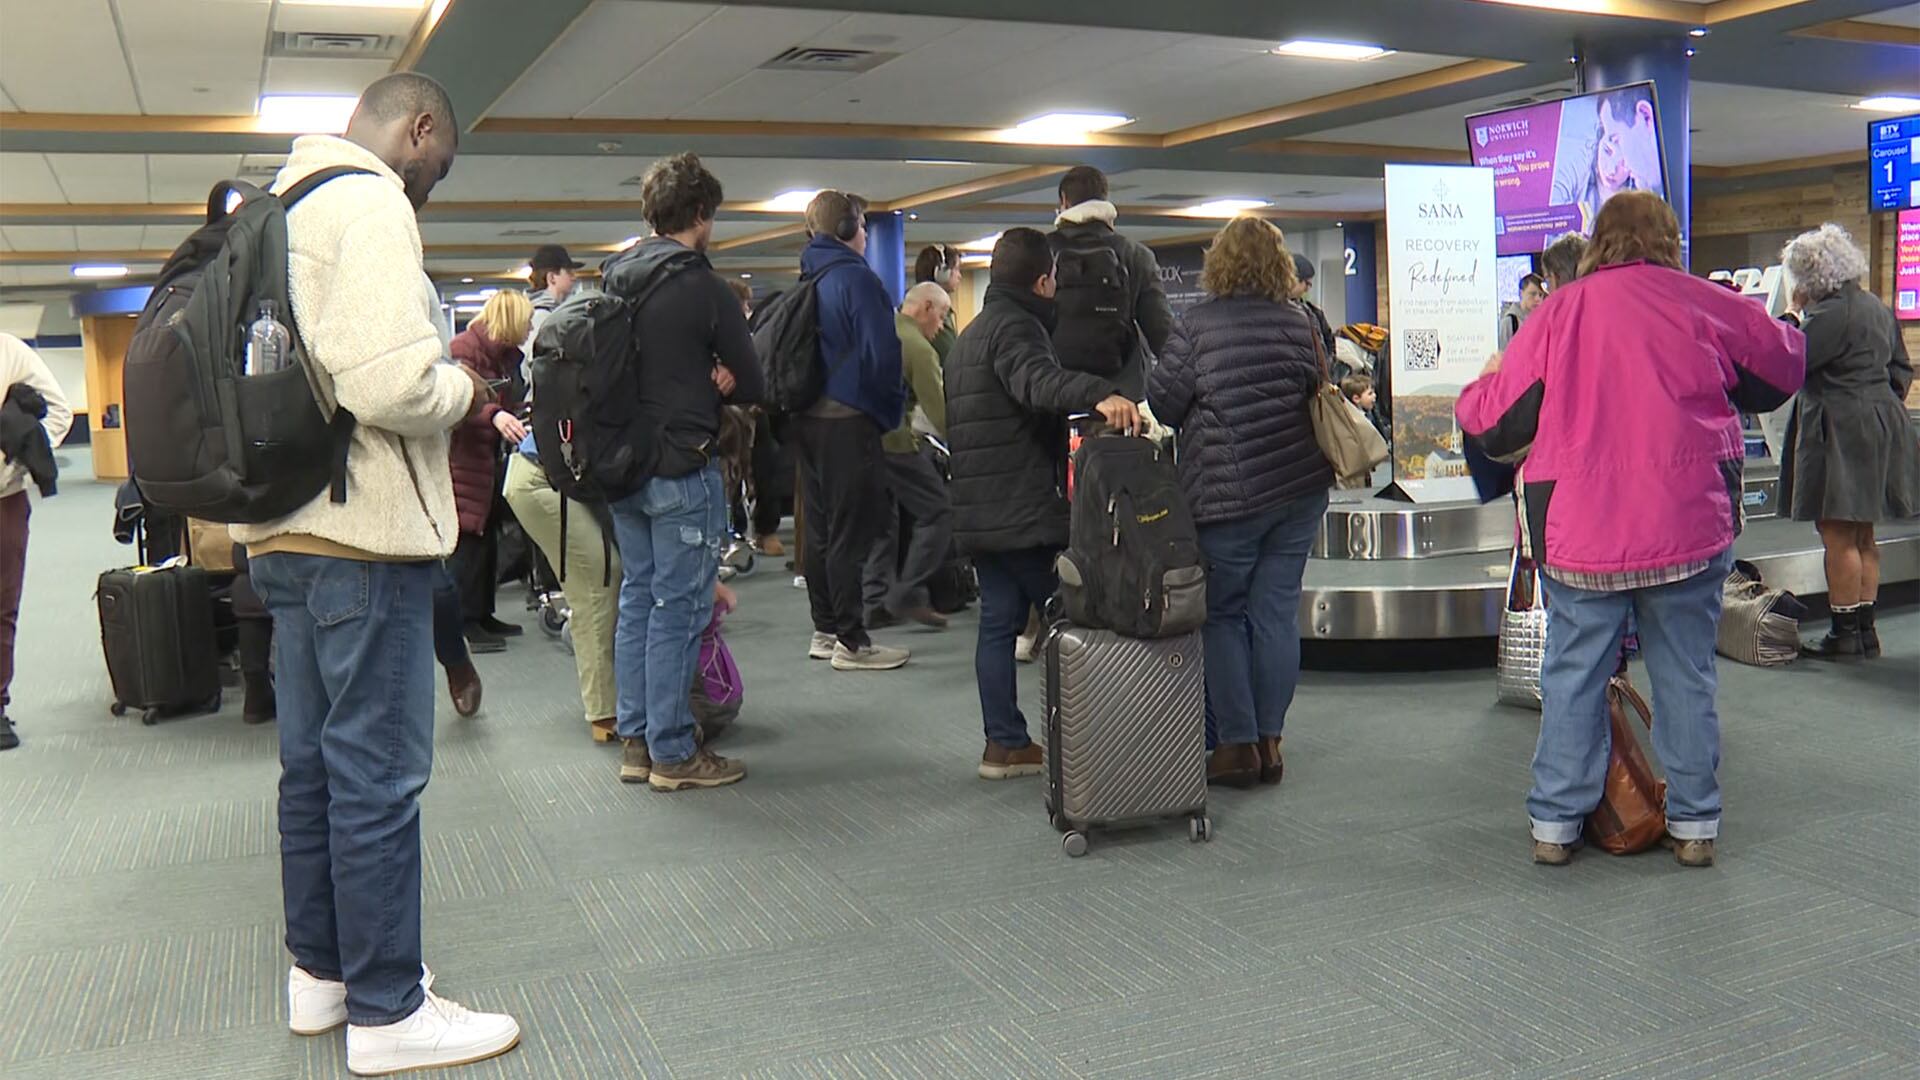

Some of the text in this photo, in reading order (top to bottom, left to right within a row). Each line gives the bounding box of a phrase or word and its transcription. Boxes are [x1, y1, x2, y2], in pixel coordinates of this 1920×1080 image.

[1489, 120, 1528, 135] NORWICH
[1880, 124, 1899, 135] BTV
[1479, 150, 1537, 166] When they say it's
[1873, 145, 1908, 158] Carousel
[1517, 162, 1530, 172] You
[1530, 161, 1550, 172] prove
[1883, 160, 1893, 184] 1
[1418, 203, 1464, 219] SANA
[1405, 238, 1480, 252] RECOVERY
[1344, 248, 1357, 275] 2
[1408, 258, 1478, 295] Redefined
[1899, 266, 1915, 276] Just
